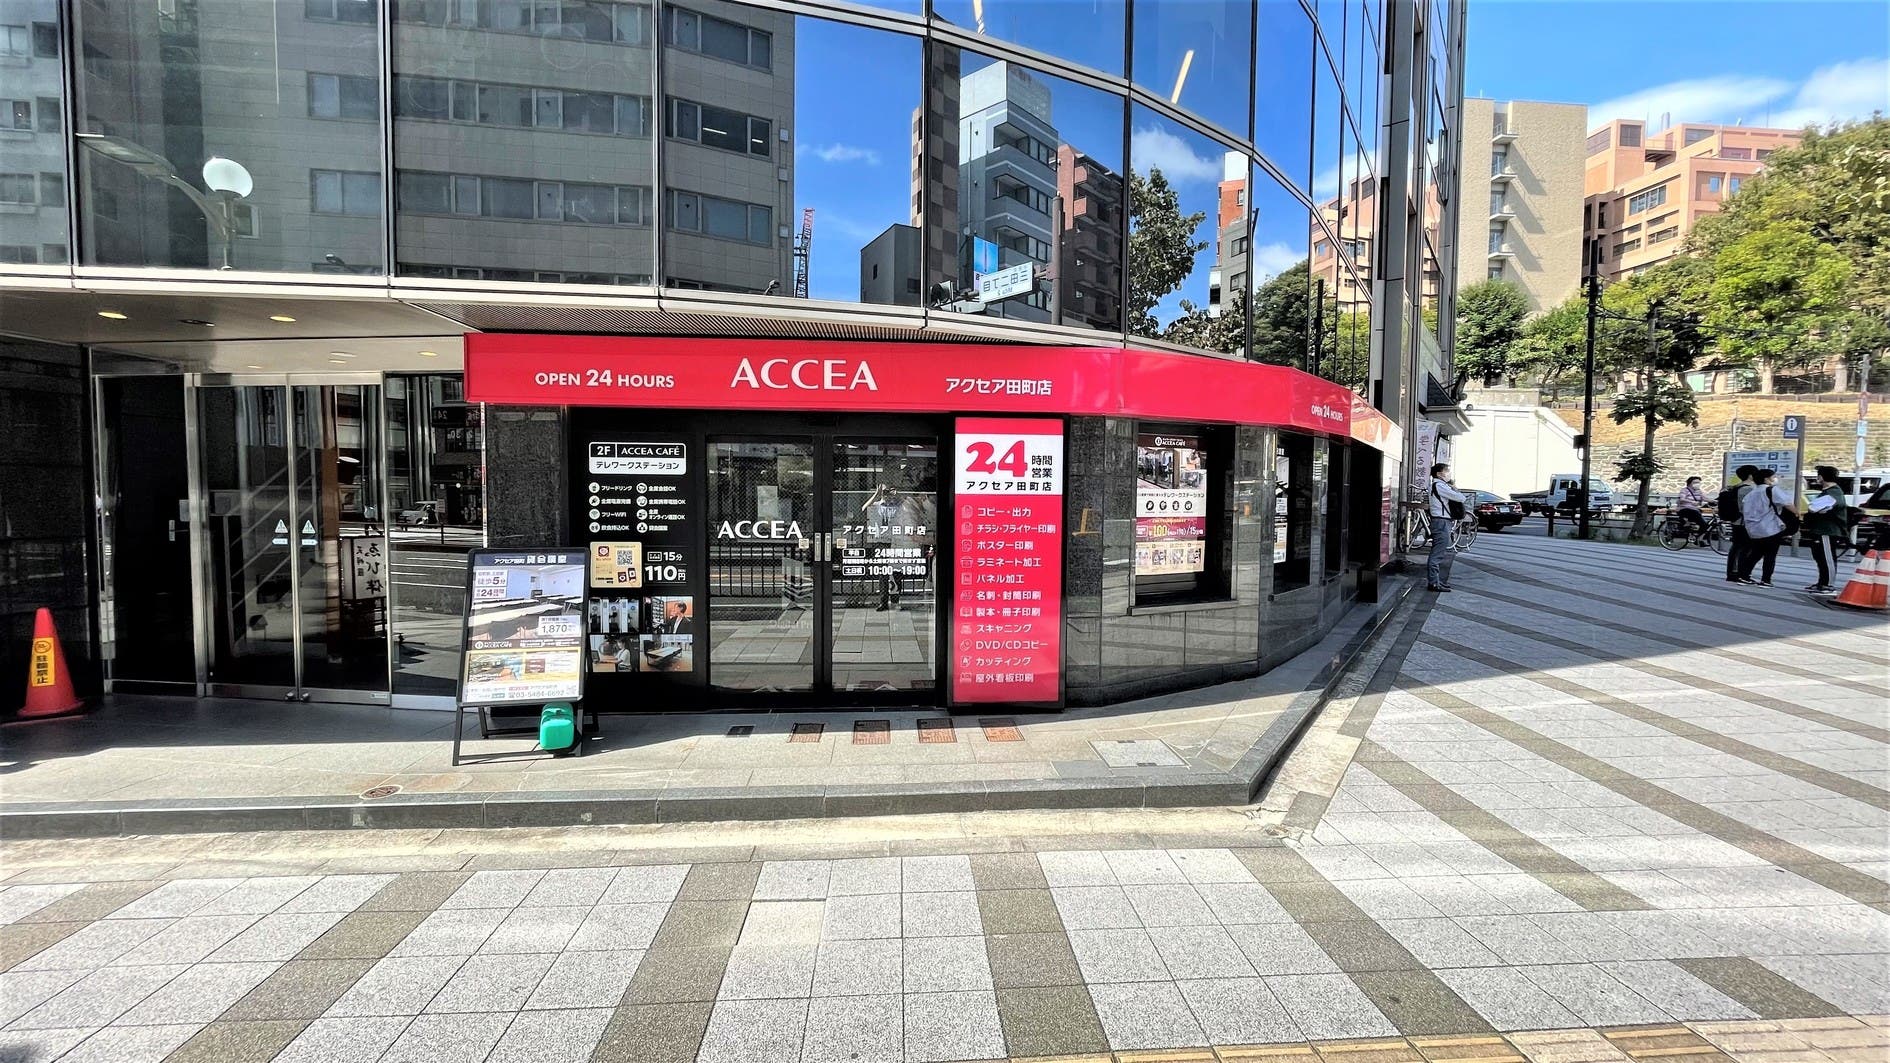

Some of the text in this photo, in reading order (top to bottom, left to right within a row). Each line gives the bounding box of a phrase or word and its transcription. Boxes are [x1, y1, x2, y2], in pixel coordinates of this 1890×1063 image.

[535, 370, 675, 389] OPEN 24 HOURS
[730, 359, 878, 391] ACCEA
[945, 377, 1053, 395] アクセア田町店
[1311, 404, 1344, 421] OPEN 24 HOURS
[596, 445, 680, 456] 2F ACCEA CAFÉ
[965, 440, 1053, 477] 24 時間
[596, 461, 680, 469] テレワークステーション
[1031, 467, 1053, 479] 営業
[966, 481, 1052, 491] アクセア田町店
[977, 507, 1031, 517] コピー・出力
[717, 520, 803, 539] ACCEA
[843, 525, 927, 535] アクセア田町店
[977, 524, 1056, 534] チラシ・フライヤー印刷
[977, 541, 1034, 550] ポスター印刷
[664, 551, 683, 561] 15分
[875, 548, 921, 558] 24時間営業
[977, 557, 1042, 567] ラミネート加工
[644, 565, 686, 581] 110円
[976, 574, 1025, 584] パネル加工
[976, 590, 1042, 601] 名刺・封筒印刷
[976, 607, 1041, 617] 製本・冊子印刷
[541, 623, 567, 635] 1,870
[976, 624, 1032, 633] スキャニング
[975, 640, 1049, 650] DVD/CDコピー
[976, 657, 1031, 666] カッティング
[975, 673, 1034, 683] 屋外看板印刷
